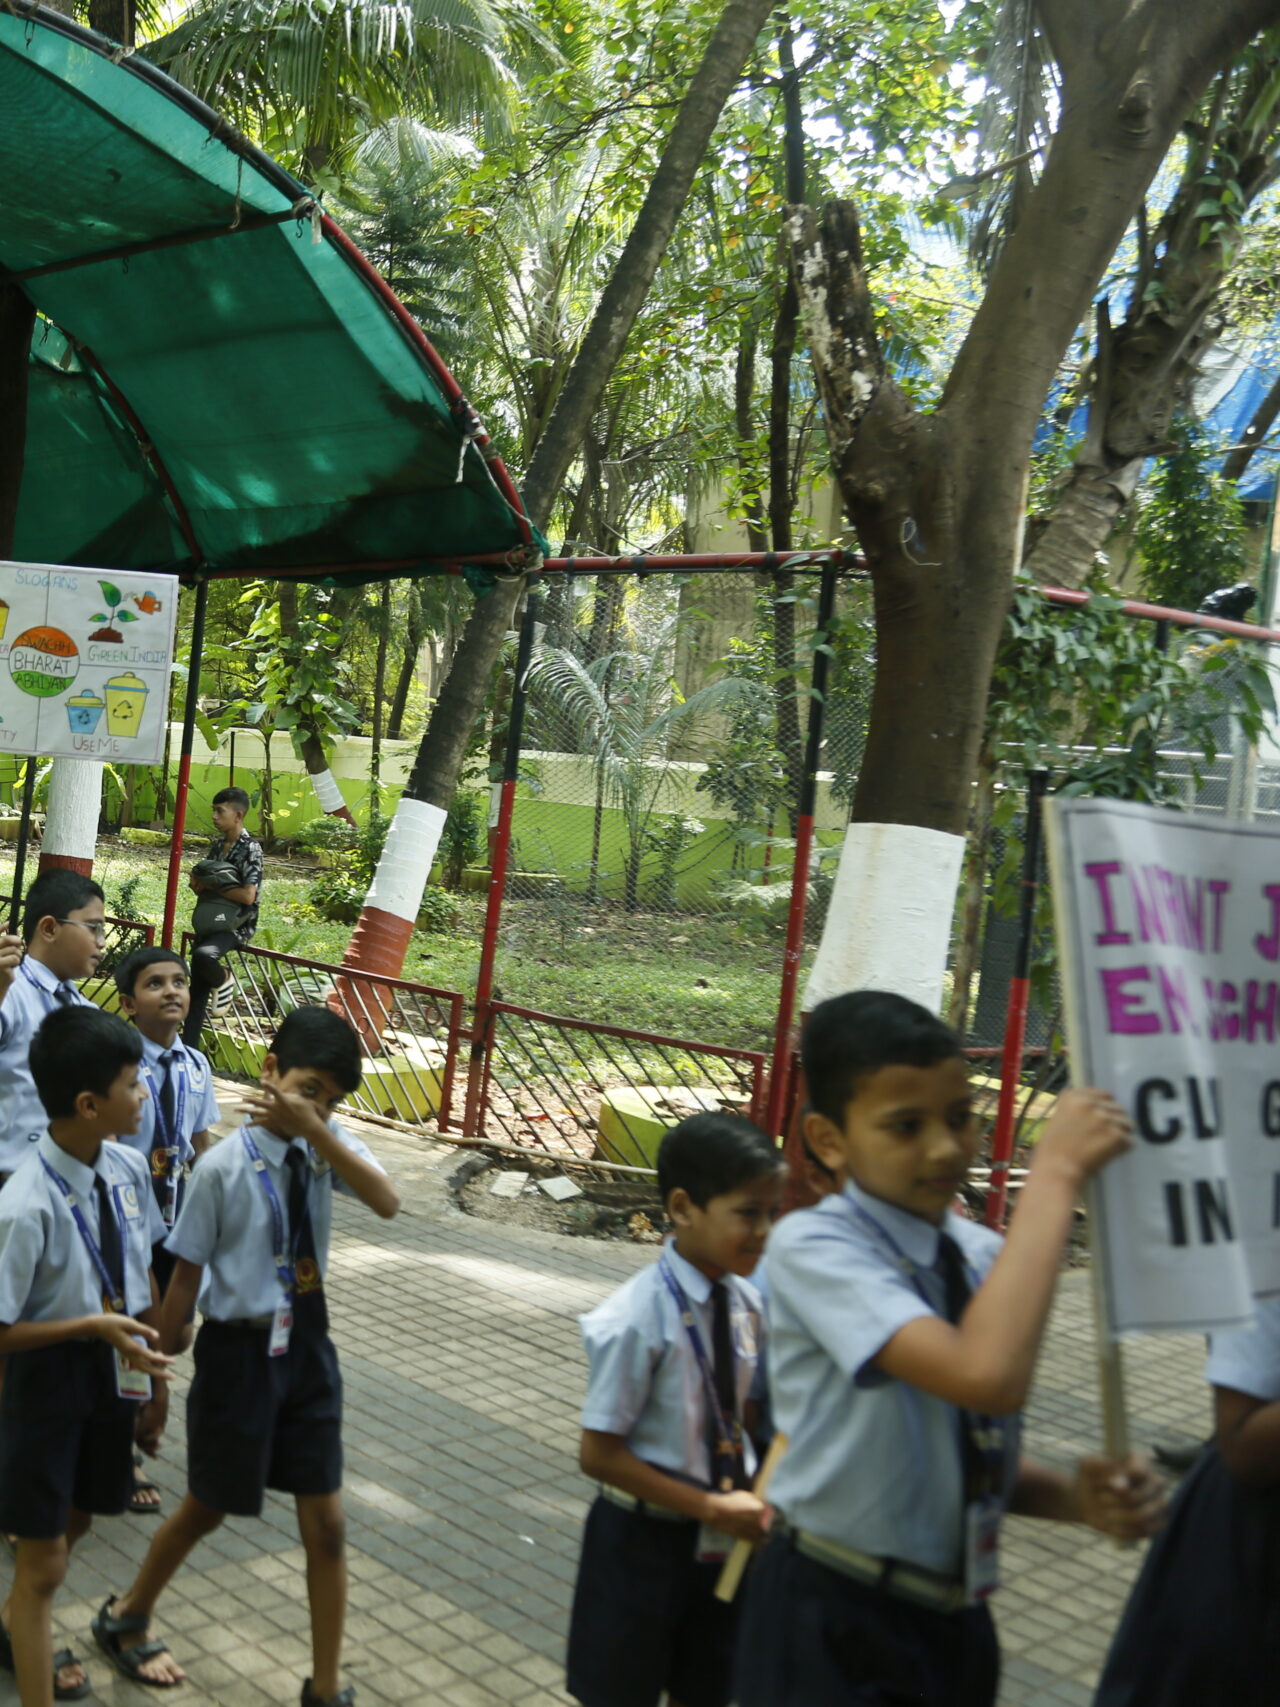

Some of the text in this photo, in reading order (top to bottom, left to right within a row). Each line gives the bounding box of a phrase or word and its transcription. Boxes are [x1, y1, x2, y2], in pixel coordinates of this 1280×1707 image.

[15, 569, 79, 591] SLOGANS
[14, 650, 71, 674] BHARAT
[88, 645, 166, 663] GREEN INDIA
[73, 736, 120, 752] USE ME
